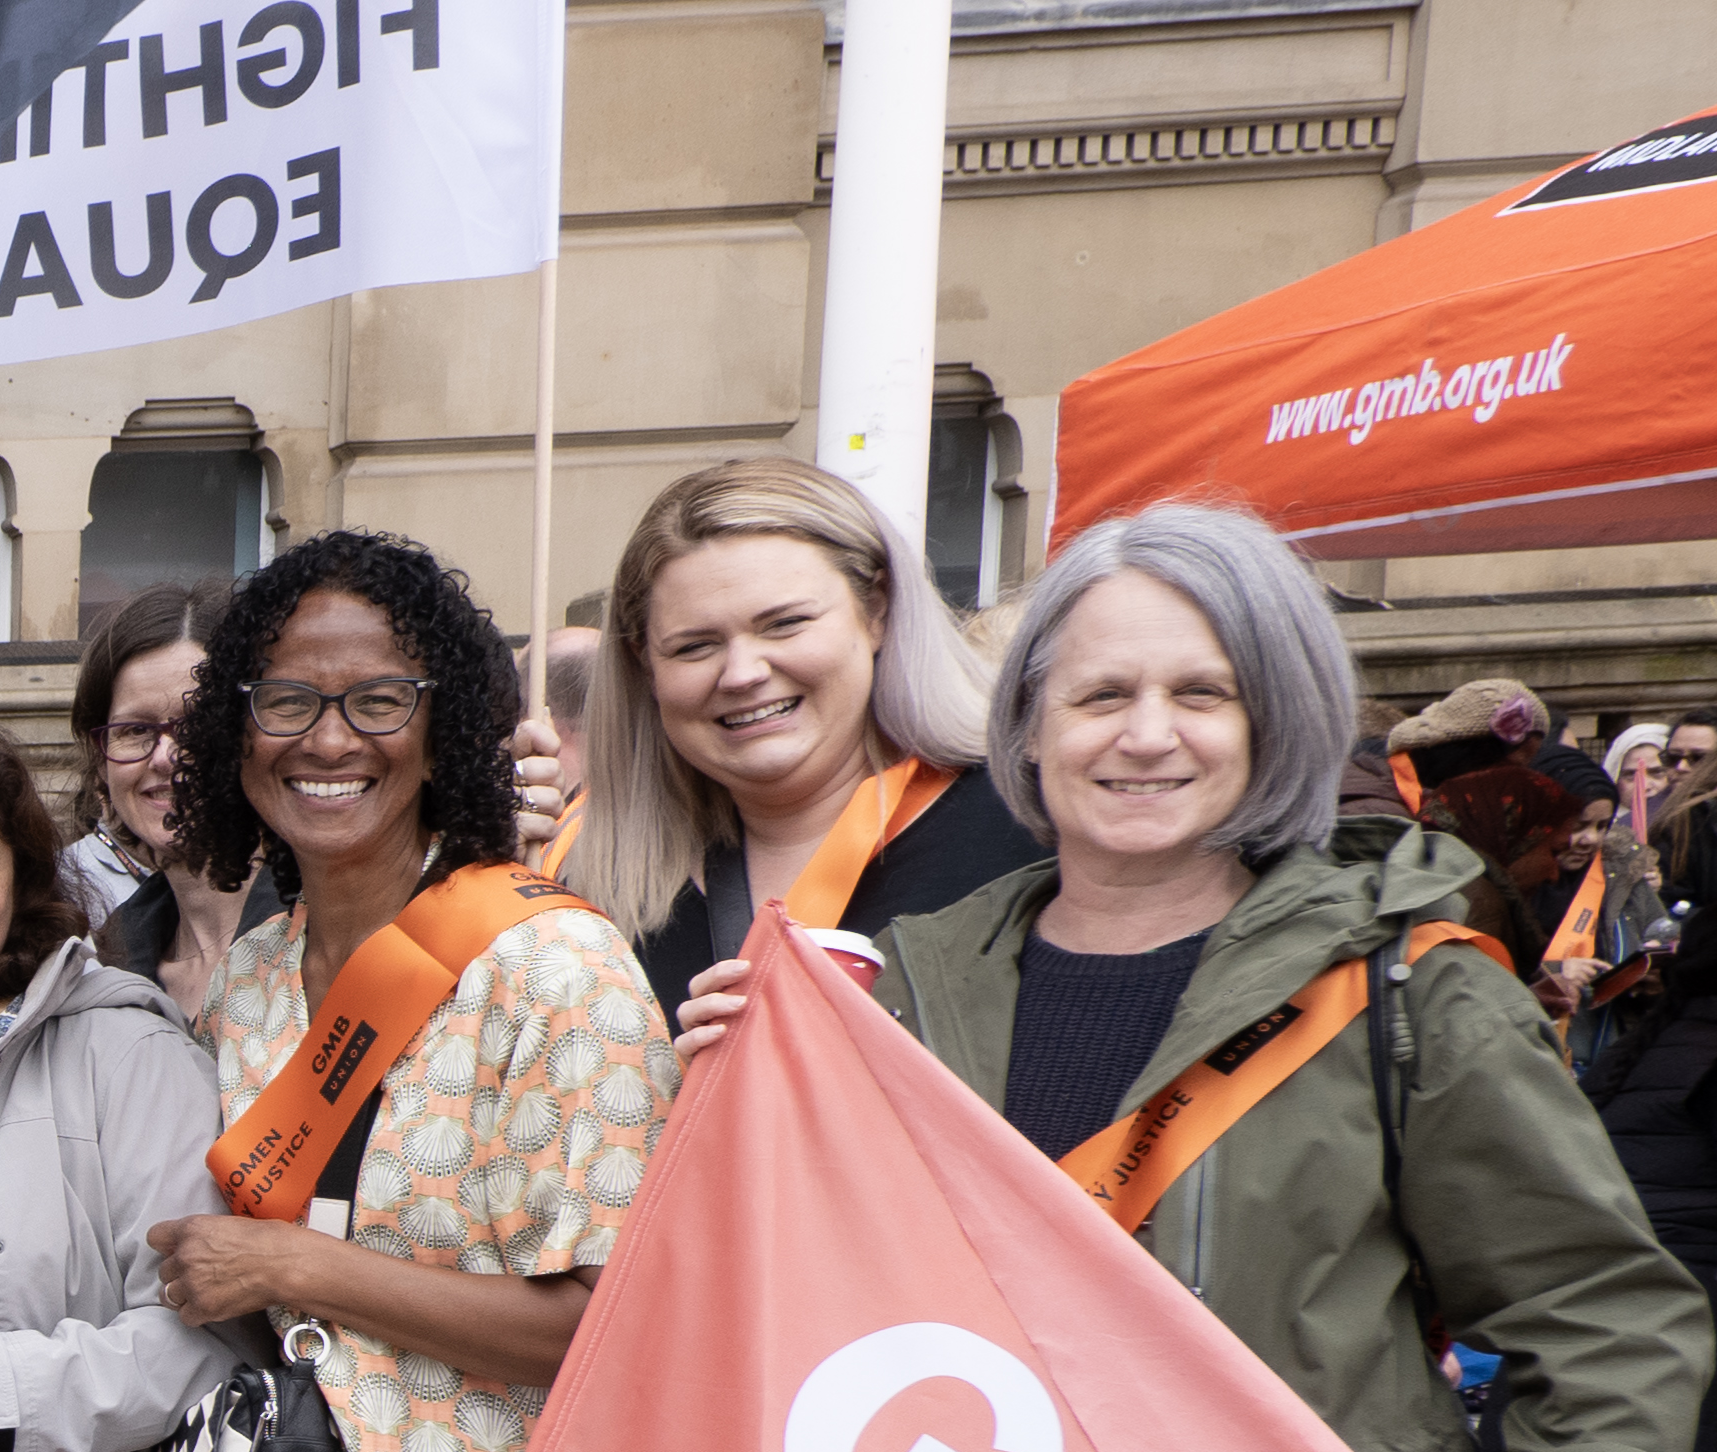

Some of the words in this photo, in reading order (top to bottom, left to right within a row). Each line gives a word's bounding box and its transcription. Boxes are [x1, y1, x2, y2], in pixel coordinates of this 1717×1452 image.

[1266, 332, 1575, 445] www.gmb.org.uk
[311, 1015, 351, 1075] GMB
[330, 1035, 367, 1090] UNION
[1222, 1012, 1285, 1061] UNION
[250, 1121, 313, 1205] JUSTICE
[1113, 1089, 1194, 1186] JUSTICE
